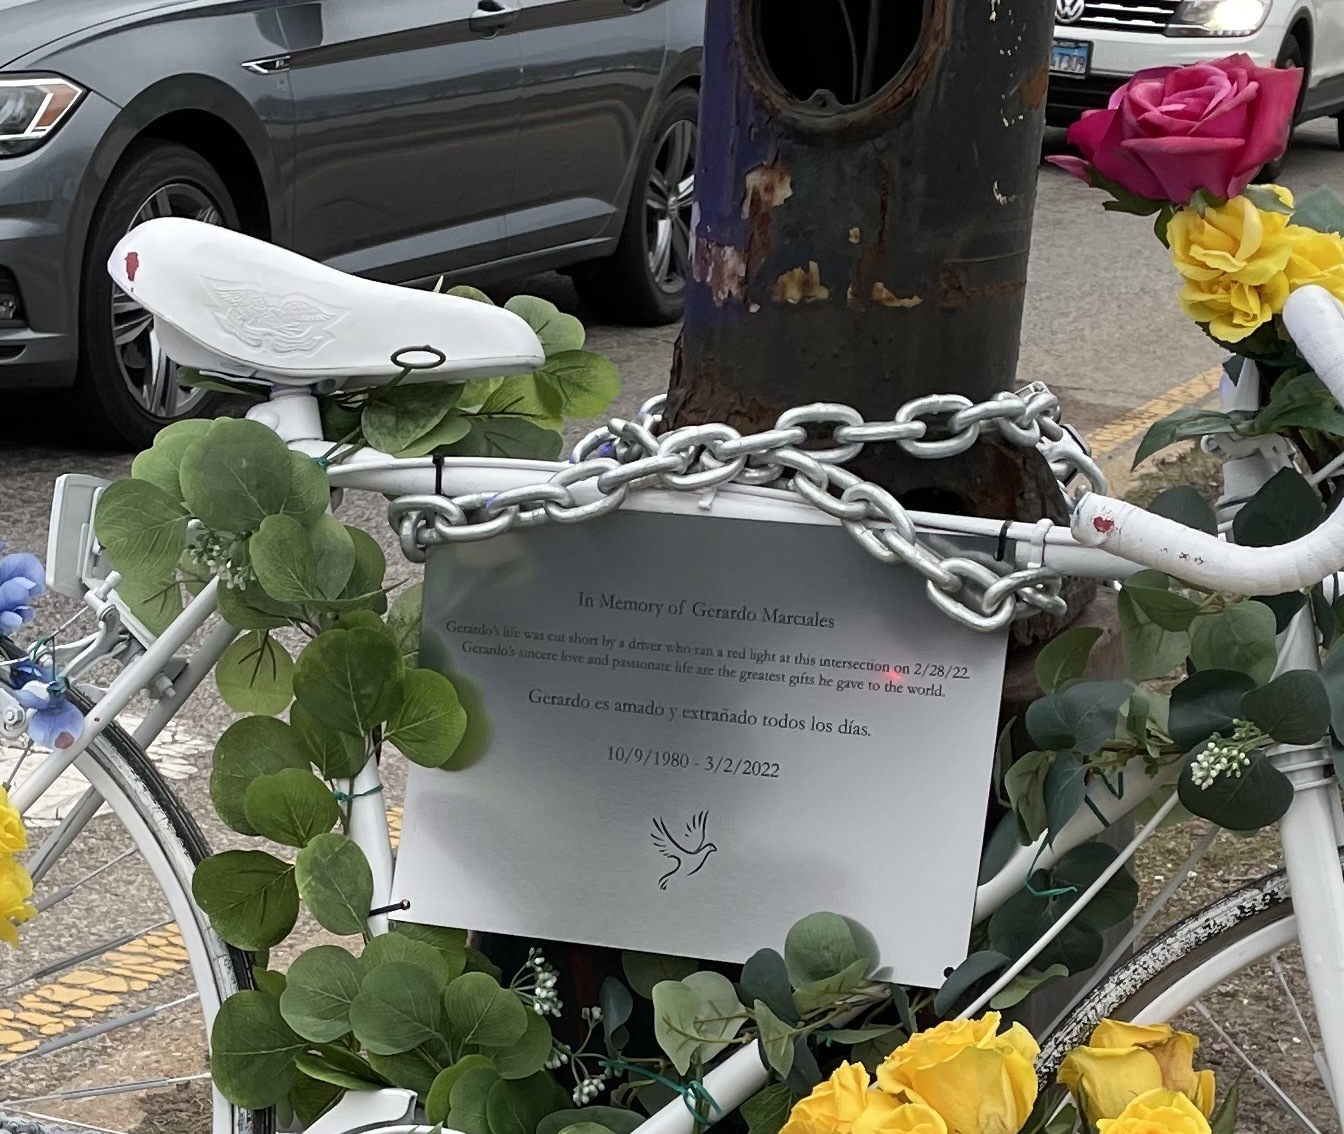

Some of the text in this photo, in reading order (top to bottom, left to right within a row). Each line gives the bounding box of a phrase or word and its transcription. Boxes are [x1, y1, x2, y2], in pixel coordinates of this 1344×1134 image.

[578, 592, 835, 629] In Memory of Gerardo Marciales
[446, 620, 500, 637] Gerardo's
[503, 625, 521, 640] life
[524, 631, 545, 642] was
[547, 632, 566, 643] cut
[569, 632, 599, 647] short
[602, 635, 617, 650] by
[618, 640, 625, 649] a
[628, 637, 662, 652] driver
[665, 640, 691, 655] who
[694, 646, 714, 657] ran
[716, 649, 723, 658] a
[727, 648, 746, 660] red
[750, 648, 776, 665] light
[779, 654, 791, 664] at
[794, 652, 816, 666] this
[819, 654, 890, 674] intersection
[893, 663, 910, 675] on
[462, 641, 946, 699] Gerardo's sincere love and passionate life are the greatest gifts he gave to the world.
[528, 688, 872, 737] Gerardo es amado y extrañado todos los días.
[608, 745, 690, 769] 10/9/1980
[703, 755, 781, 779] 3/2/2022
